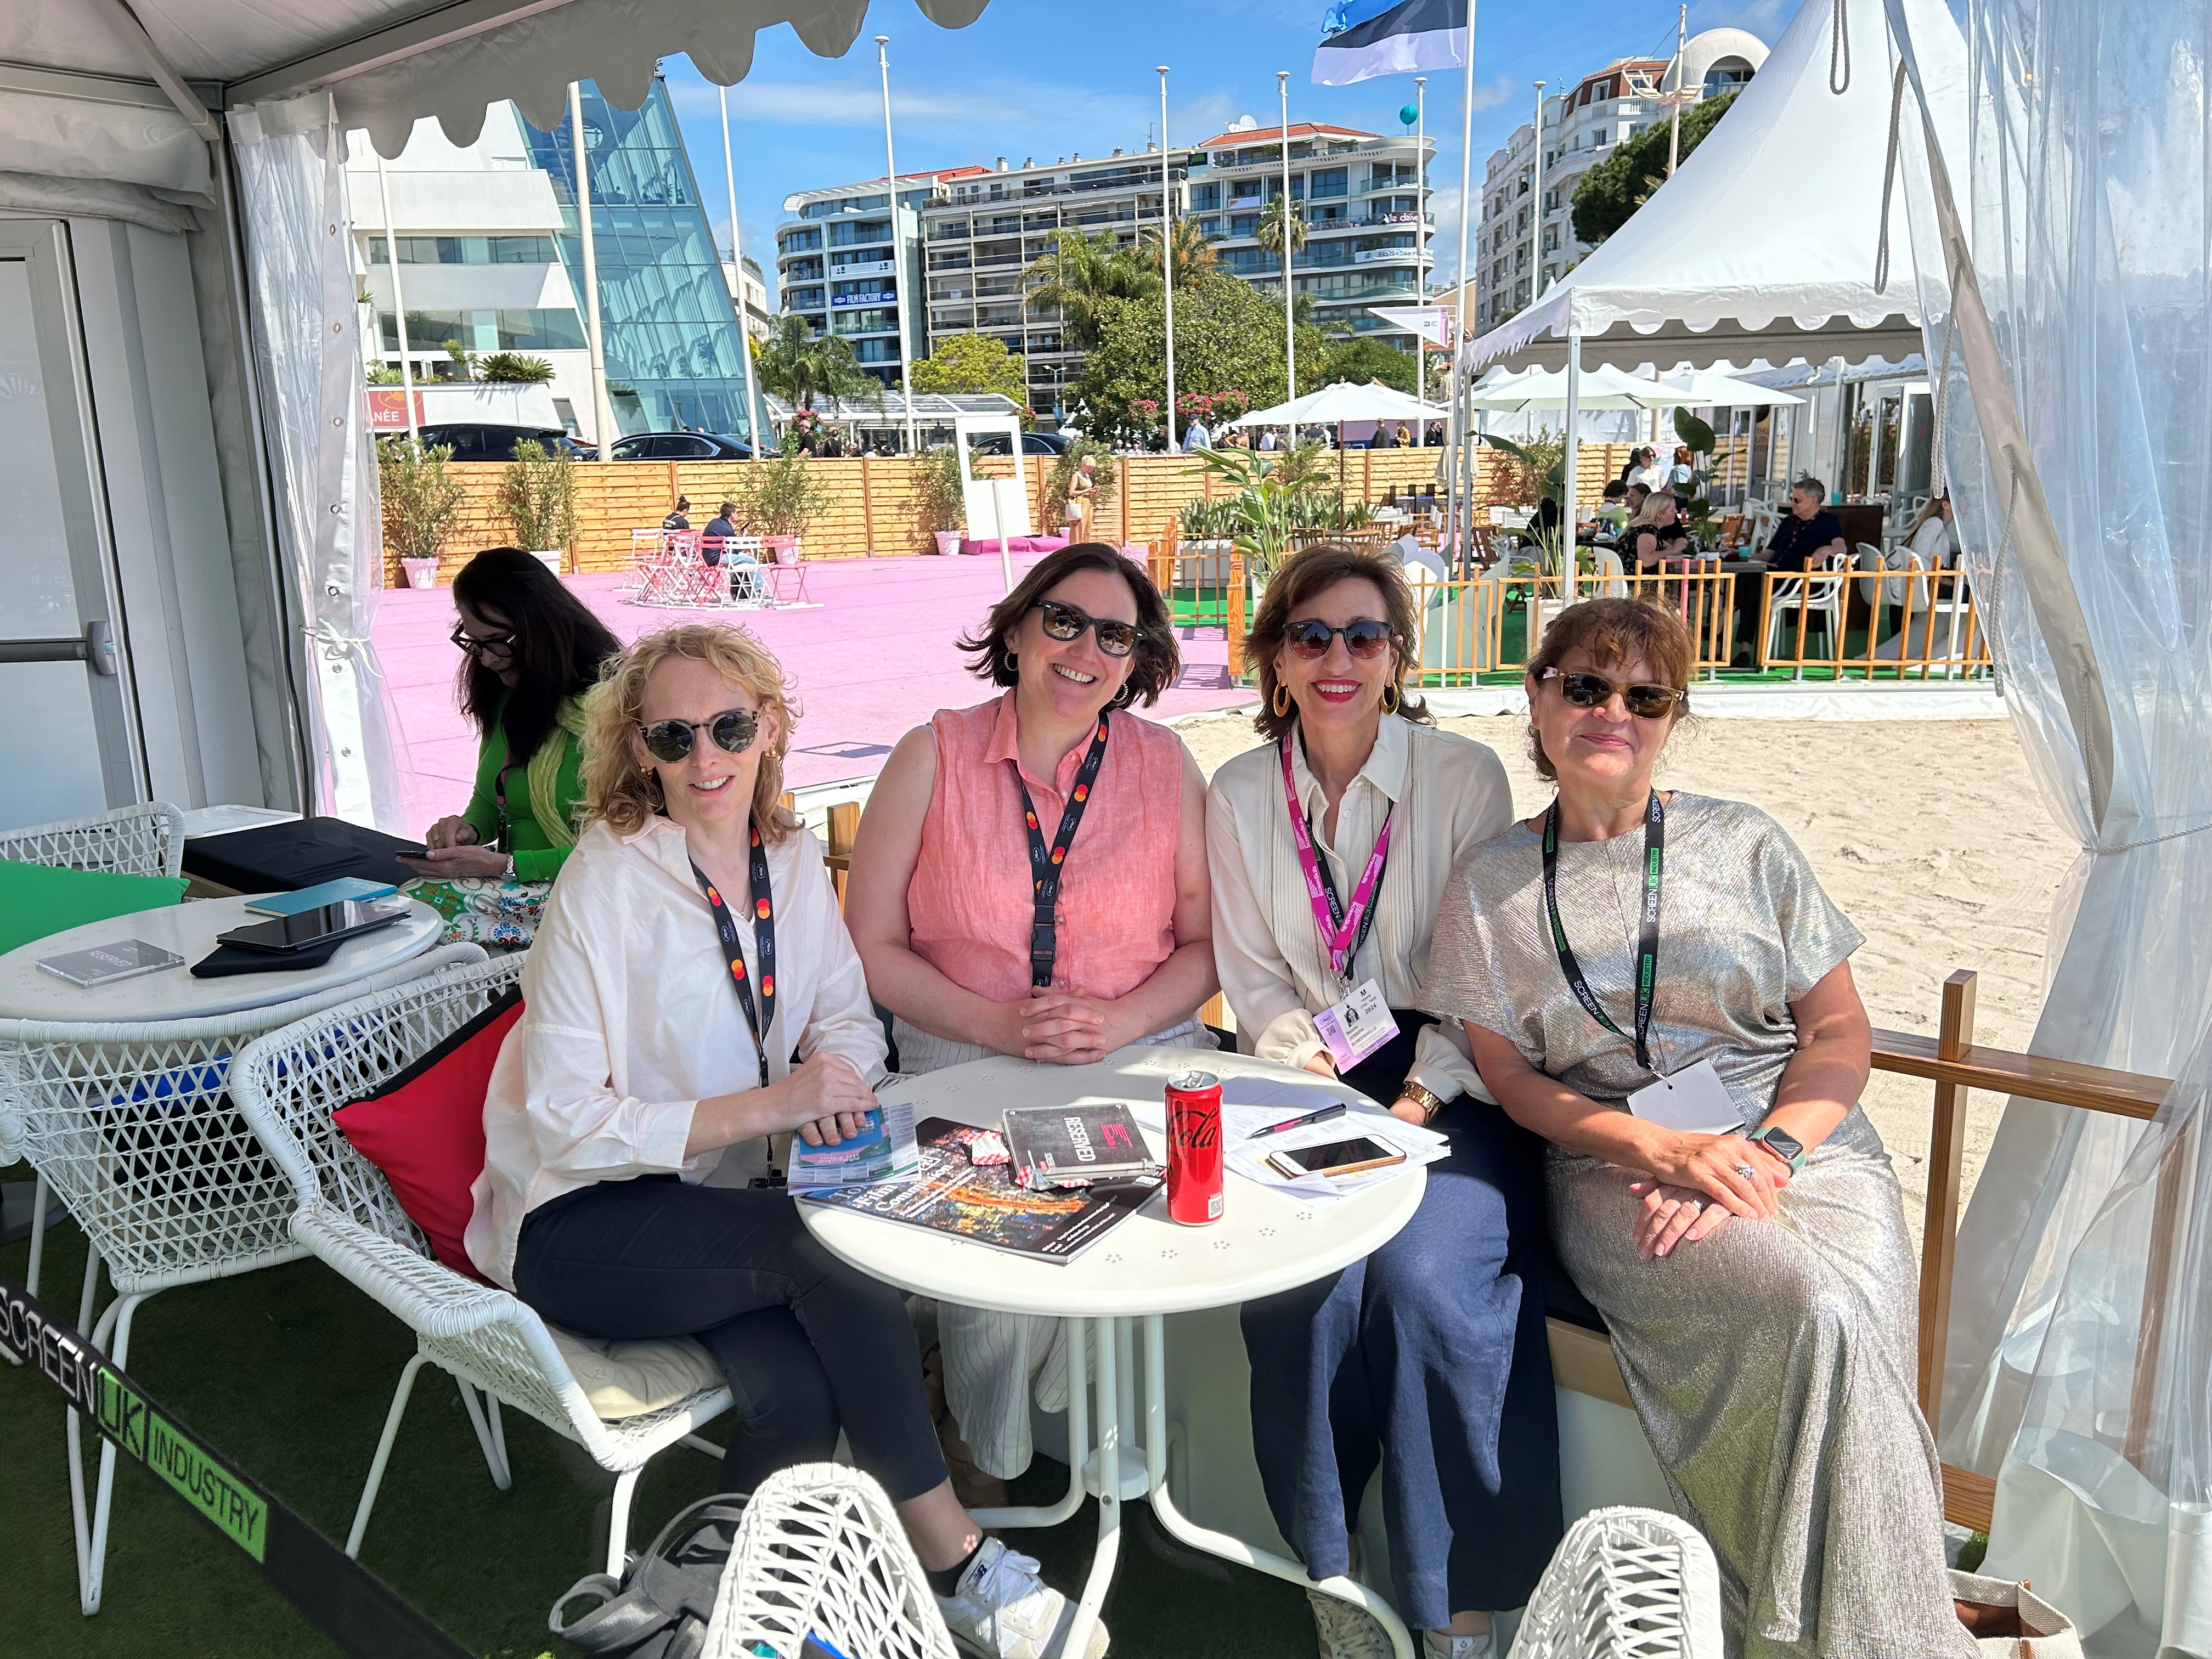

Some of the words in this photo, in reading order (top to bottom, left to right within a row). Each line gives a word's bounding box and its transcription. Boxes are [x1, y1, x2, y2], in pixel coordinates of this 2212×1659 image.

[847, 294, 859, 304] FILM
[859, 292, 882, 303] FACTORY
[373, 408, 400, 422] NÉE
[1652, 797, 1661, 823] SCREEN
[1299, 817, 1311, 849] ScreenSkills
[1312, 865, 1324, 897] ScreenSkills
[1362, 853, 1378, 884] ScreenSkills
[1649, 875, 1658, 888] UK
[1325, 887, 1341, 919] SCREEN
[1340, 901, 1358, 932] ScreenSkills
[1548, 877, 1556, 911] SCREEN
[1555, 923, 1565, 950] INDUSTRY
[1646, 889, 1658, 923] SCREEN
[87, 950, 132, 967] RESERVED
[1643, 956, 1651, 986] INDUSTRY
[1360, 989, 1367, 997] M
[1574, 980, 1600, 1015] SCREEN
[1641, 988, 1650, 1003] UK
[1364, 1003, 1378, 1015] 2024
[1638, 1003, 1649, 1041] SCREEN
[1064, 1116, 1097, 1162] RESERVED
[853, 1184, 899, 1207] Film
[0, 1286, 97, 1415] SCREEN
[99, 1370, 143, 1458] UK
[154, 1426, 259, 1541] INDUSTRY
